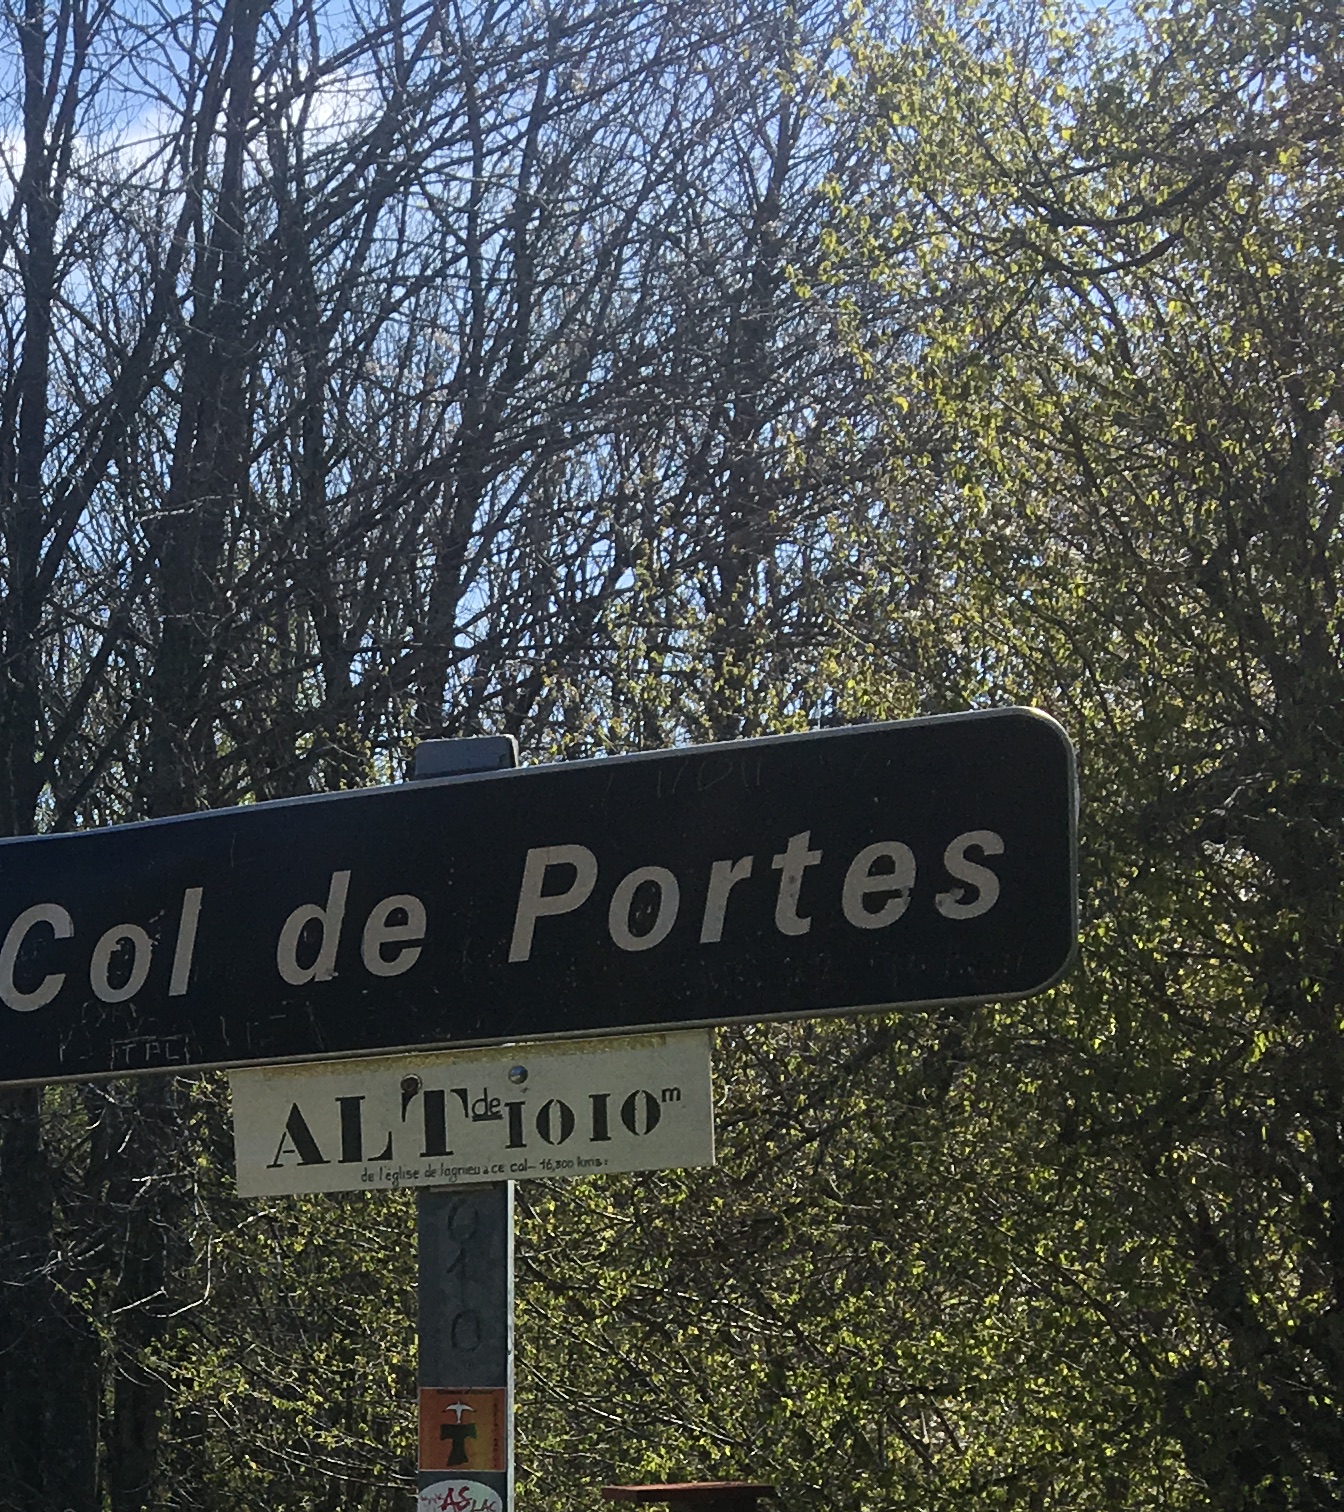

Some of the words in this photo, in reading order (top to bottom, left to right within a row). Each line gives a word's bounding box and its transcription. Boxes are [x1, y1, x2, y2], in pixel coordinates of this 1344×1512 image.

[275, 869, 428, 986] de
[508, 828, 1008, 963] Portes
[265, 1087, 469, 1169] ALT
[471, 1086, 505, 1122] de
[360, 1166, 375, 1183] de
[423, 1162, 438, 1179] de
